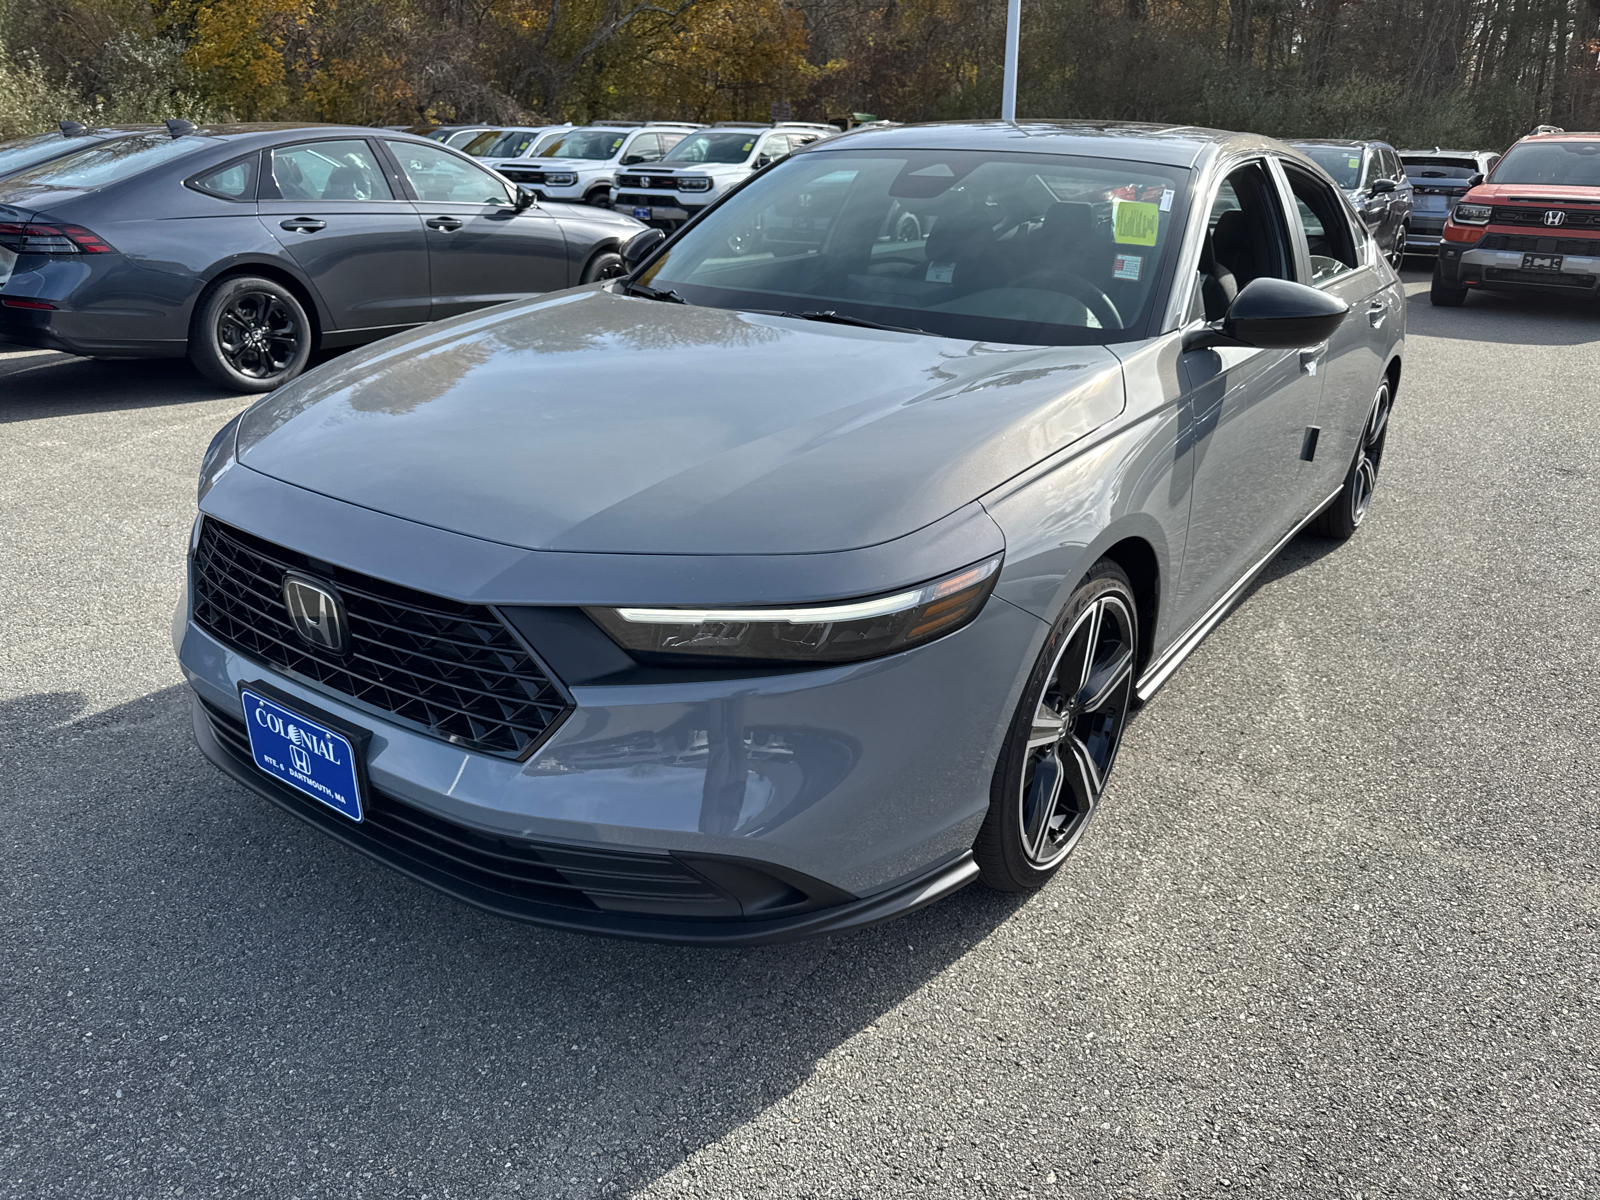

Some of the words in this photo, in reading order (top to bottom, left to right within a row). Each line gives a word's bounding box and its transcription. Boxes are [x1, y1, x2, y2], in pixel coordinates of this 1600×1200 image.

[255, 708, 341, 766] COLONIAL
[263, 754, 280, 769] RTE.
[279, 763, 285, 771] 6
[288, 768, 334, 799] DARTMOUTH,
[334, 792, 347, 805] MA
